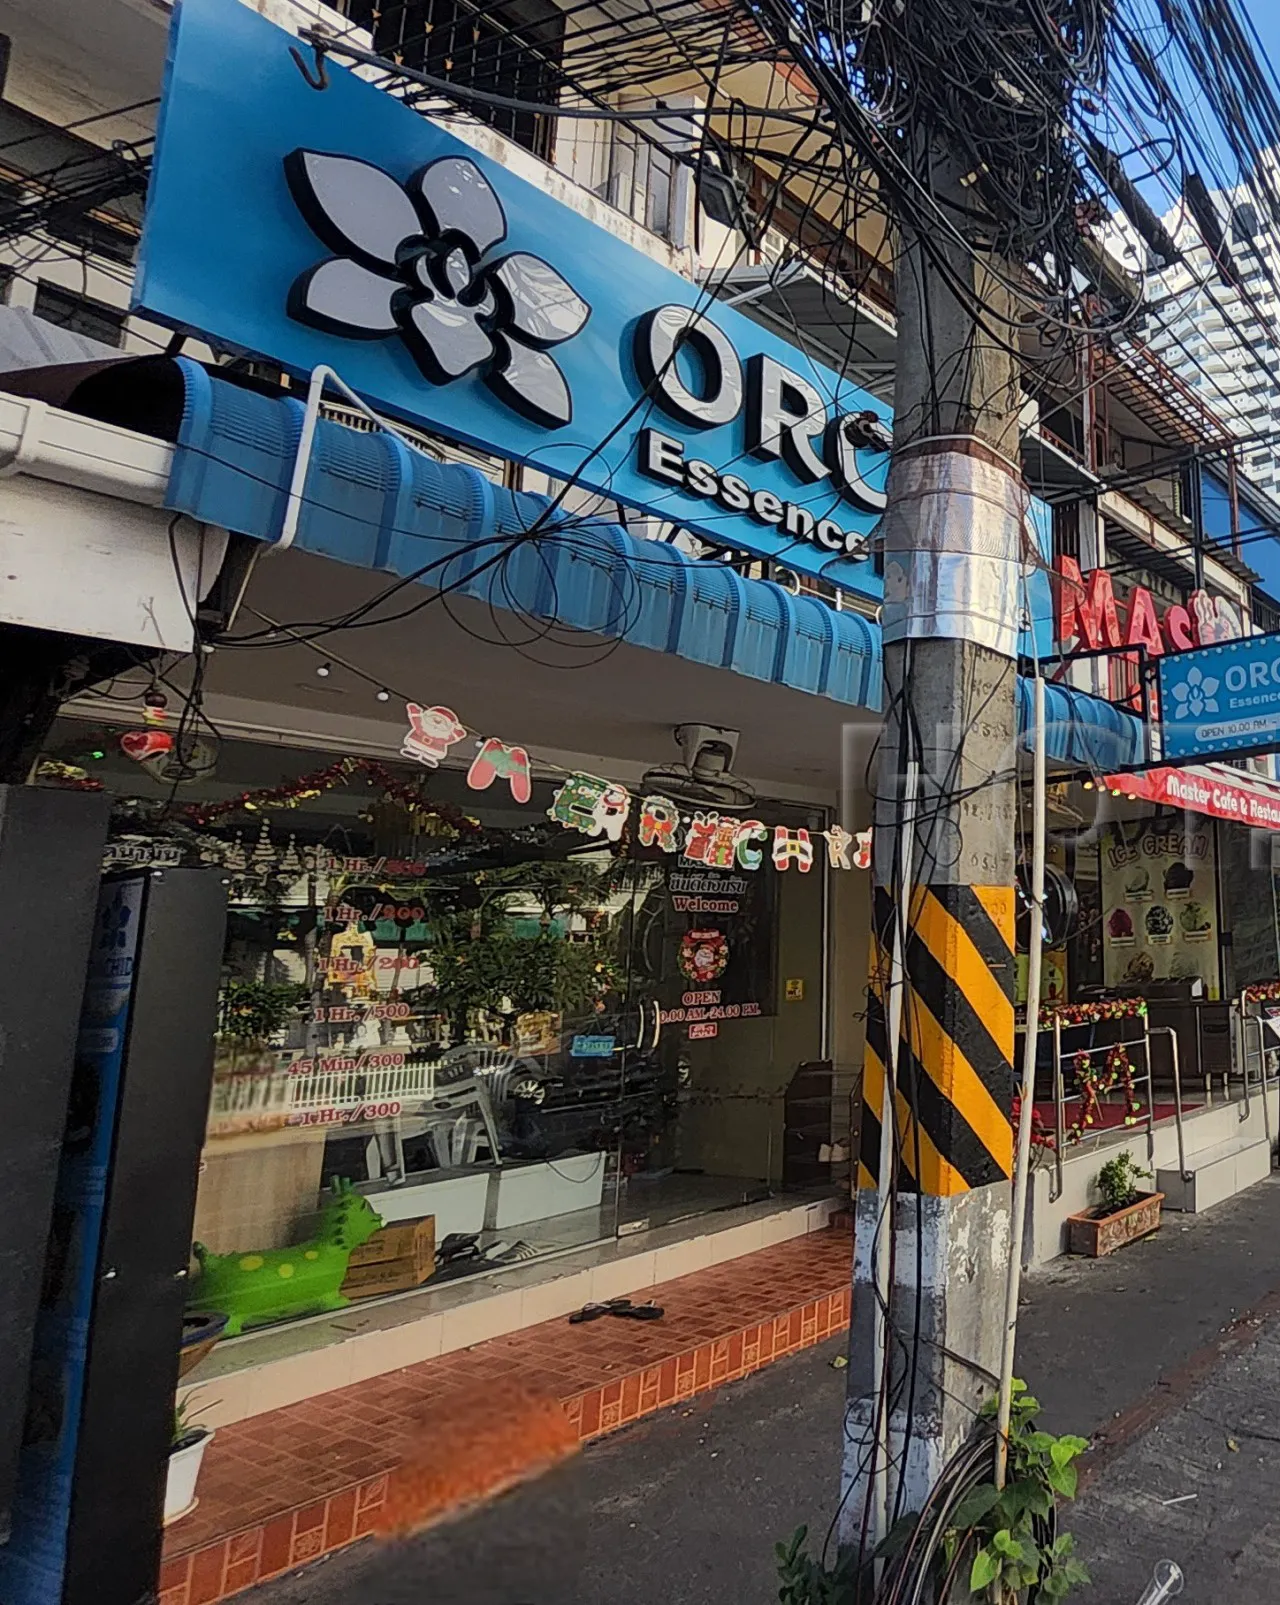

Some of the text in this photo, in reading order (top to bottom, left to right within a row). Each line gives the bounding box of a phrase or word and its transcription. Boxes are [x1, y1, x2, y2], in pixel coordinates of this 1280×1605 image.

[638, 428, 869, 562] Essence
[1201, 723, 1224, 737] OPEN
[1228, 720, 1250, 734] 10.00
[1167, 774, 1210, 805] Master
[1212, 788, 1238, 812] Cafe
[1240, 799, 1248, 816] &
[1108, 832, 1209, 868] ICE CREAM
[672, 895, 739, 914] Welcome
[682, 990, 721, 1006] OPEN
[314, 1007, 325, 1022] 1
[288, 1060, 314, 1076] 45
[301, 1109, 314, 1125] 1
